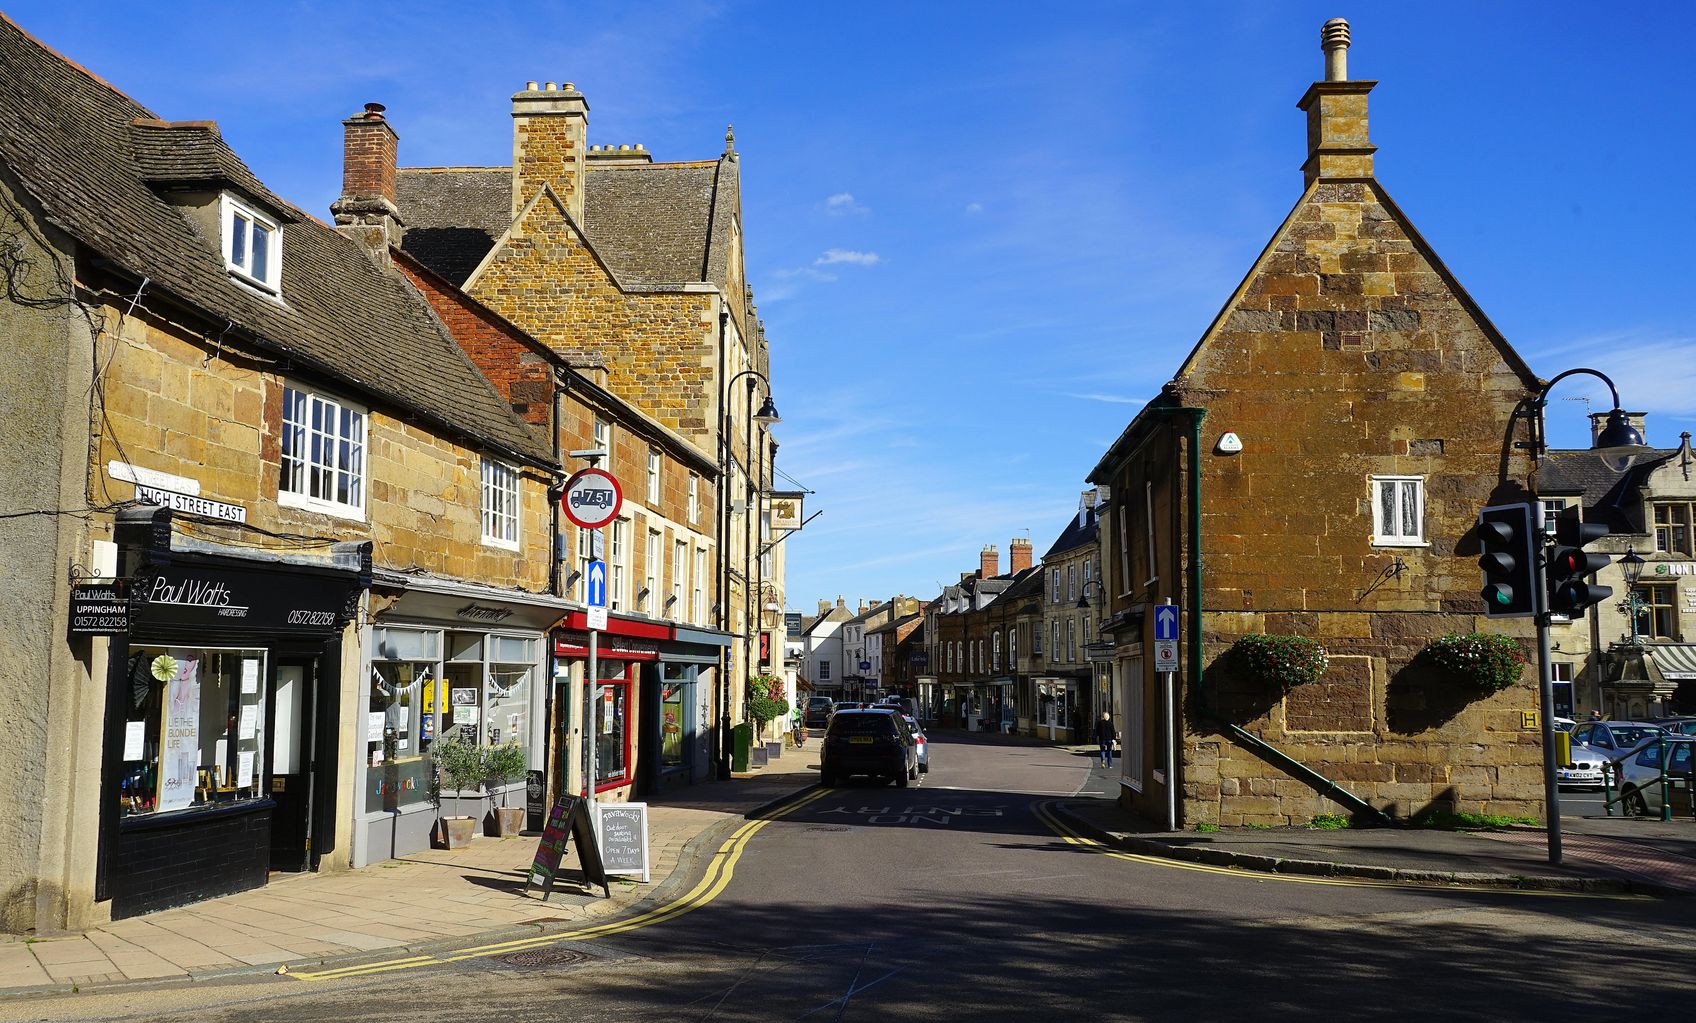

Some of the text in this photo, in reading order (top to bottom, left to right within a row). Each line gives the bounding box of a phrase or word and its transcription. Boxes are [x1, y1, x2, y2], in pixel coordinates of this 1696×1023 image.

[585, 490, 611, 503] 7.5T
[141, 488, 243, 520] HIGH STREET EAST
[75, 589, 116, 600] Paul Watts
[150, 576, 231, 606] Paul Watts
[76, 605, 126, 614] UPPINGHAM
[74, 616, 128, 627] 01572 822158
[287, 610, 336, 626] 01572 822158
[1524, 713, 1536, 726] H
[168, 728, 196, 738] BLONDE
[167, 739, 180, 749] LIFE
